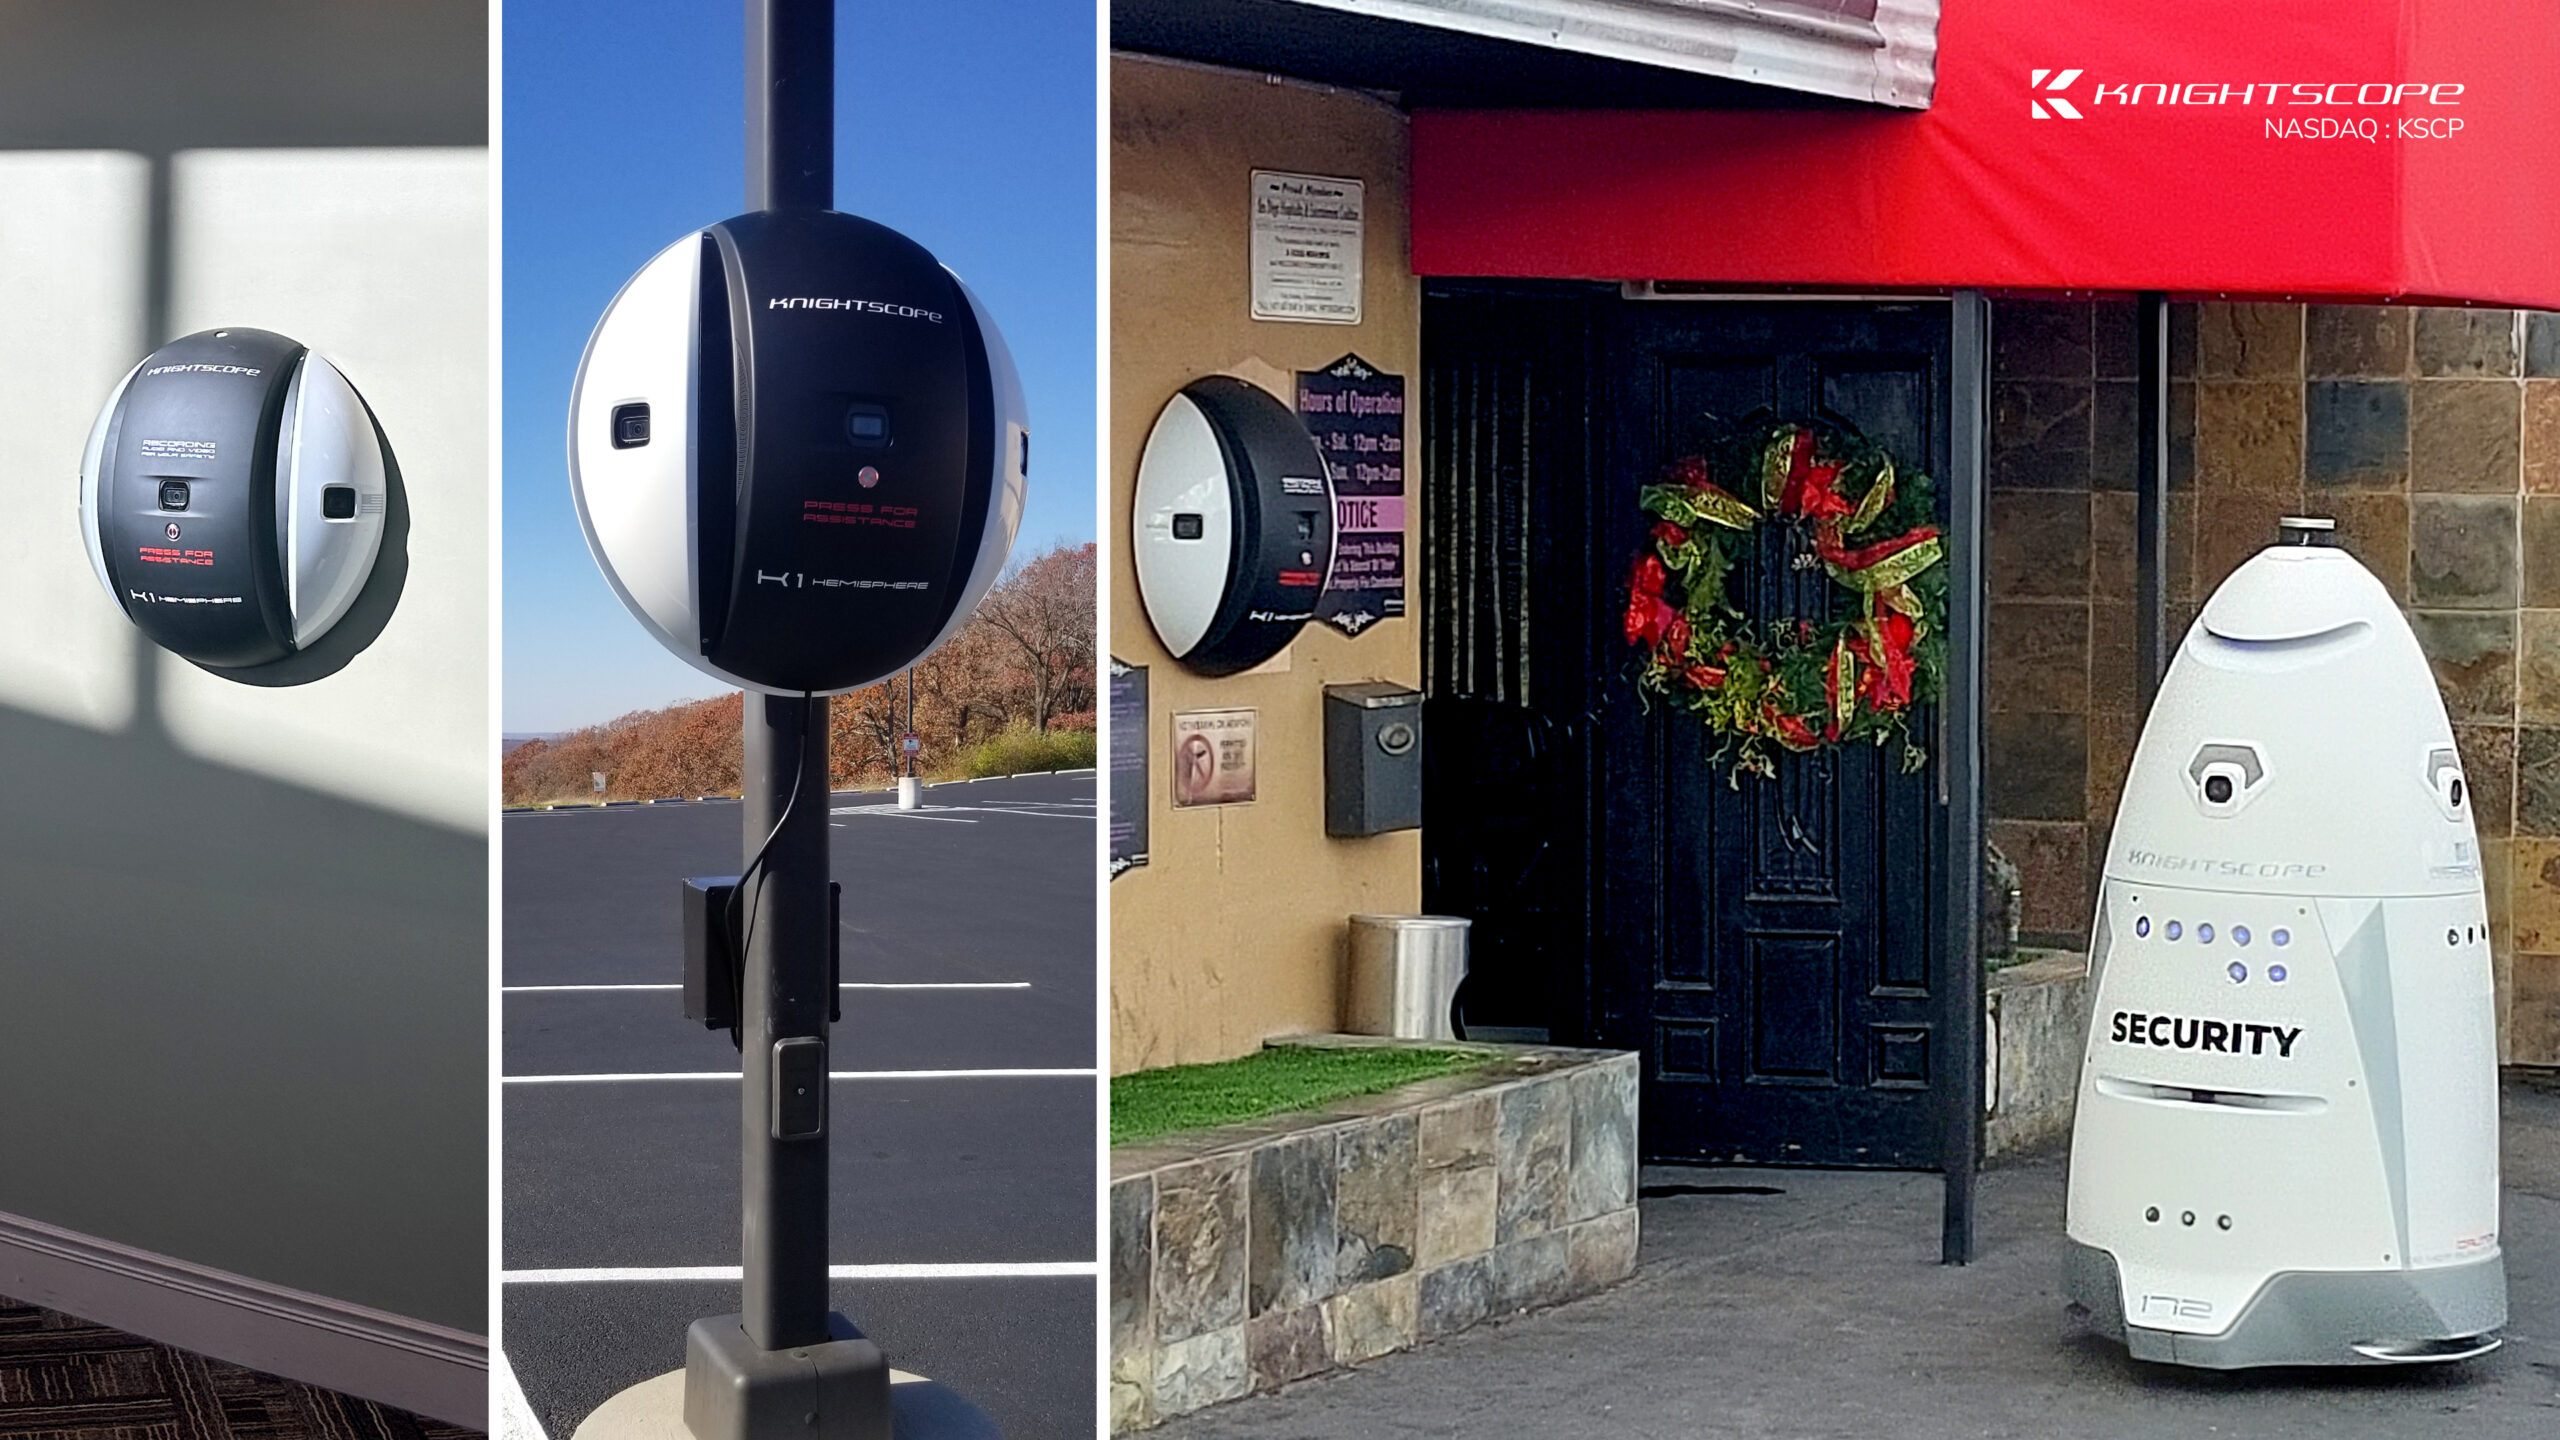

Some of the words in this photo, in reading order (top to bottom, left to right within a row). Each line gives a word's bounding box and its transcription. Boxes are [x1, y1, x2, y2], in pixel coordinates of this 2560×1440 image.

[769, 297, 943, 324] KNIGHTSCOPE
[146, 364, 261, 377] KNIGHTSCOPE
[1299, 388, 1333, 413] Hours
[1335, 389, 1348, 413] of
[1350, 389, 1403, 419] Operation
[142, 439, 217, 449] RECORDING
[804, 500, 874, 514] PRESS
[880, 505, 919, 517] FOR
[1338, 500, 1379, 531] OTICE
[803, 513, 916, 529] ASSISTANCE
[139, 547, 181, 556] PRESS
[184, 549, 214, 558] FOR
[140, 555, 214, 566] ASSISTANCE
[757, 569, 804, 588] K1
[812, 578, 929, 590] HEMISPHERE
[129, 588, 156, 603] K1
[2127, 848, 2327, 878] KNIGHTSCOPE
[2111, 1010, 2303, 1058] SECURITY
[2141, 1294, 2213, 1319] 172
